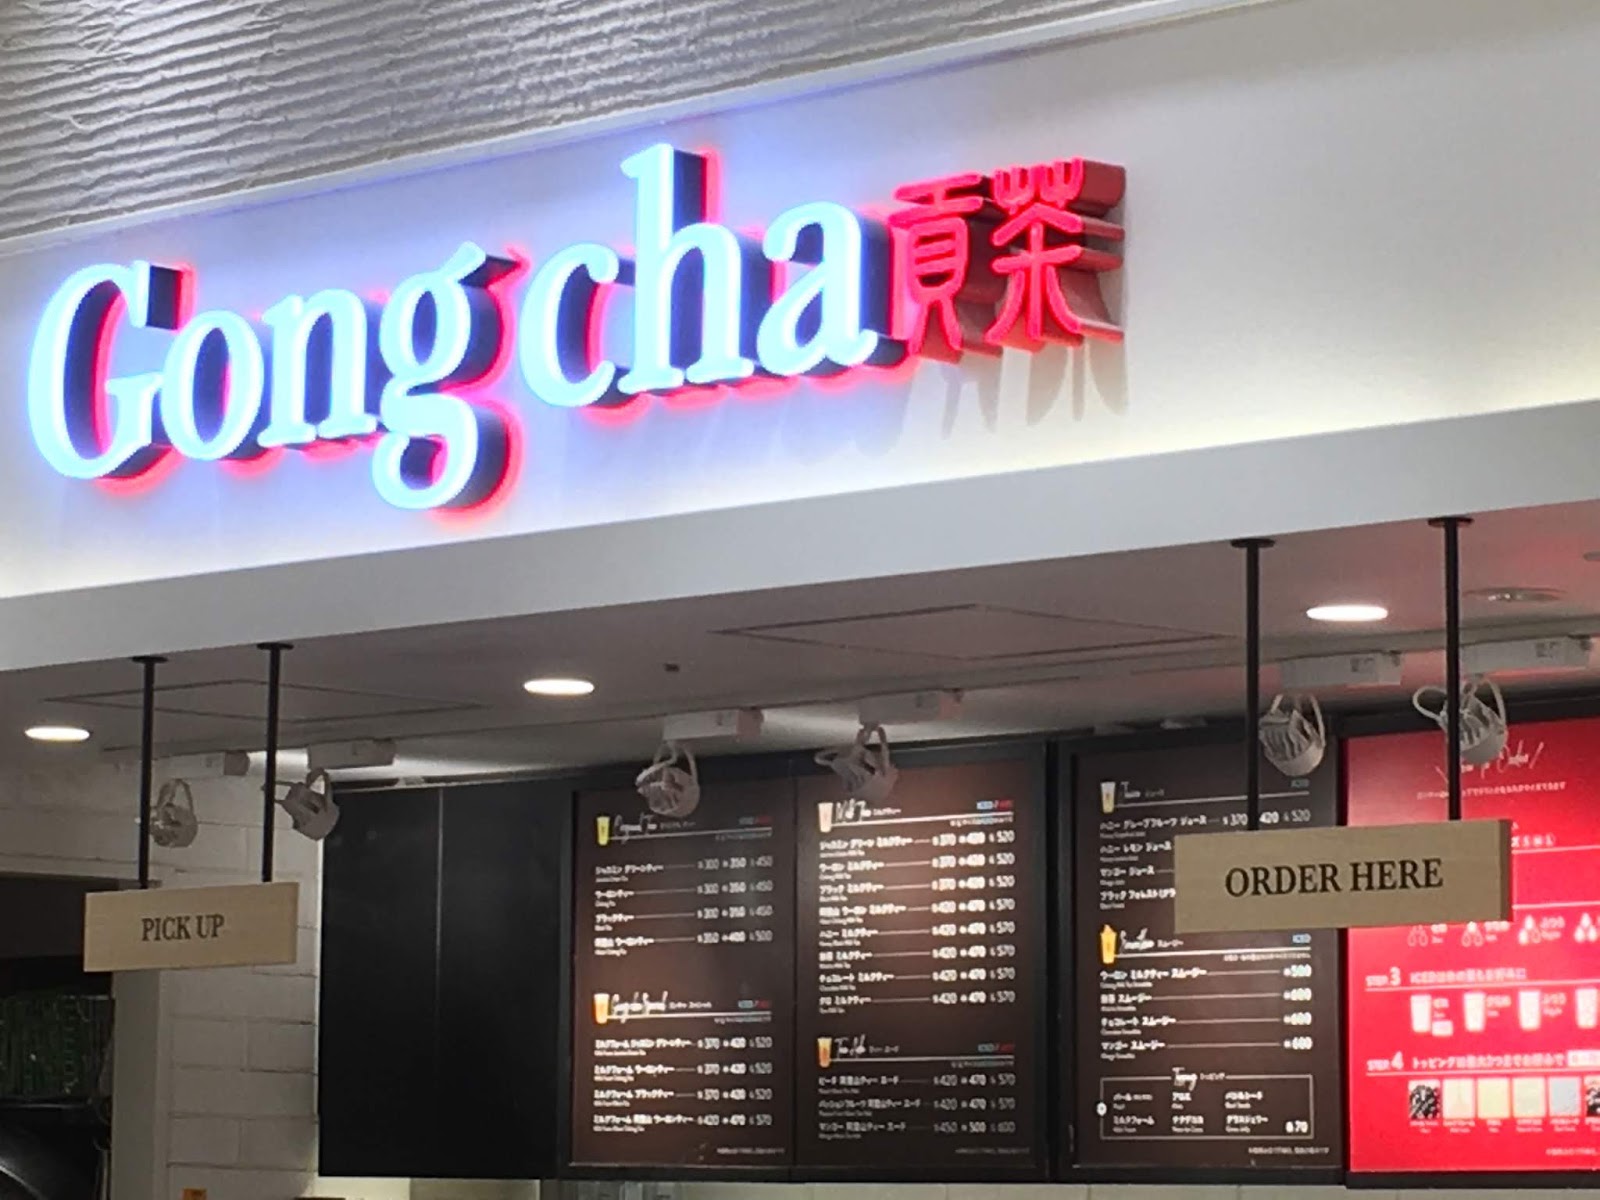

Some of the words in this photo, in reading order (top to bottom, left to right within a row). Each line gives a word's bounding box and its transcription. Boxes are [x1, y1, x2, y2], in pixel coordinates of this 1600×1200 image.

[888, 156, 1094, 358] 貢茶
[28, 240, 488, 510] Gong
[516, 142, 882, 408] cha
[1229, 814, 1248, 826] 370
[1290, 809, 1311, 821] 520
[1225, 864, 1337, 898] ORDER
[1350, 858, 1444, 892] HERE
[141, 916, 191, 941] PICK
[196, 914, 224, 938] UP
[1392, 1052, 1403, 1069] 4
